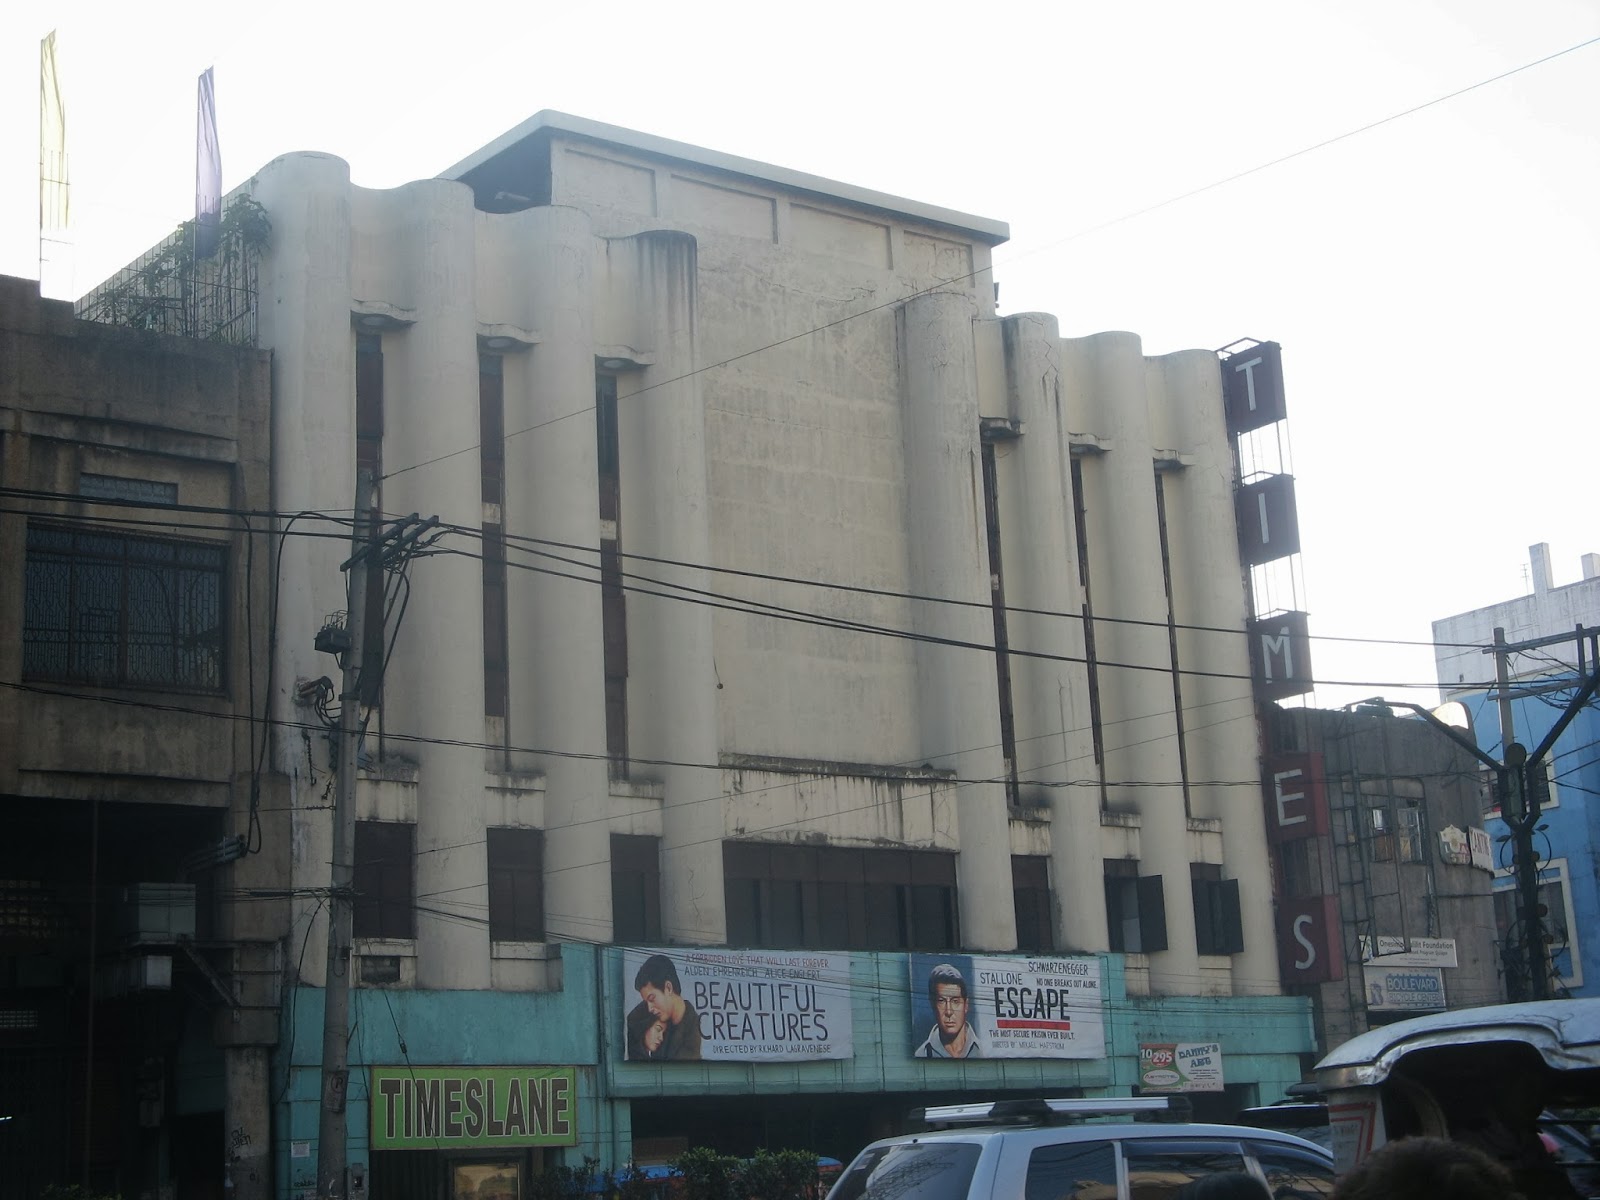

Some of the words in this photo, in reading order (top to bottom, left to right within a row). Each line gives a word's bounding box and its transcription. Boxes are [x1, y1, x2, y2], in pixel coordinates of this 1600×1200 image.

[1422, 941, 1454, 949] Foundation
[728, 955, 744, 965] LOVE
[746, 955, 763, 965] THAT
[766, 956, 782, 966] WILL
[784, 957, 800, 967] LAST
[802, 958, 829, 968] FOREVER
[684, 966, 710, 976] ALDEN
[1028, 961, 1089, 976] SCHWARZENEGGER
[979, 972, 1023, 985] STALLONE
[1036, 978, 1043, 986] NO
[1044, 978, 1054, 987] ONE
[1054, 978, 1073, 988] BREAKS
[1073, 979, 1083, 988] OUT
[1387, 978, 1438, 990] BOULEVARD
[694, 981, 826, 1013] BEAUTIFUL
[993, 987, 1071, 1021] ESCAPE
[699, 1012, 829, 1042] CREATURES
[989, 1029, 999, 1038] THE
[1047, 1031, 1059, 1039] EVER
[712, 1044, 749, 1054] DIRECTED
[750, 1045, 758, 1054] BY
[759, 1044, 784, 1053] RICHARD
[1141, 1048, 1153, 1059] 10
[1152, 1051, 1173, 1063] 295
[379, 1078, 570, 1139] TIMESLANE
